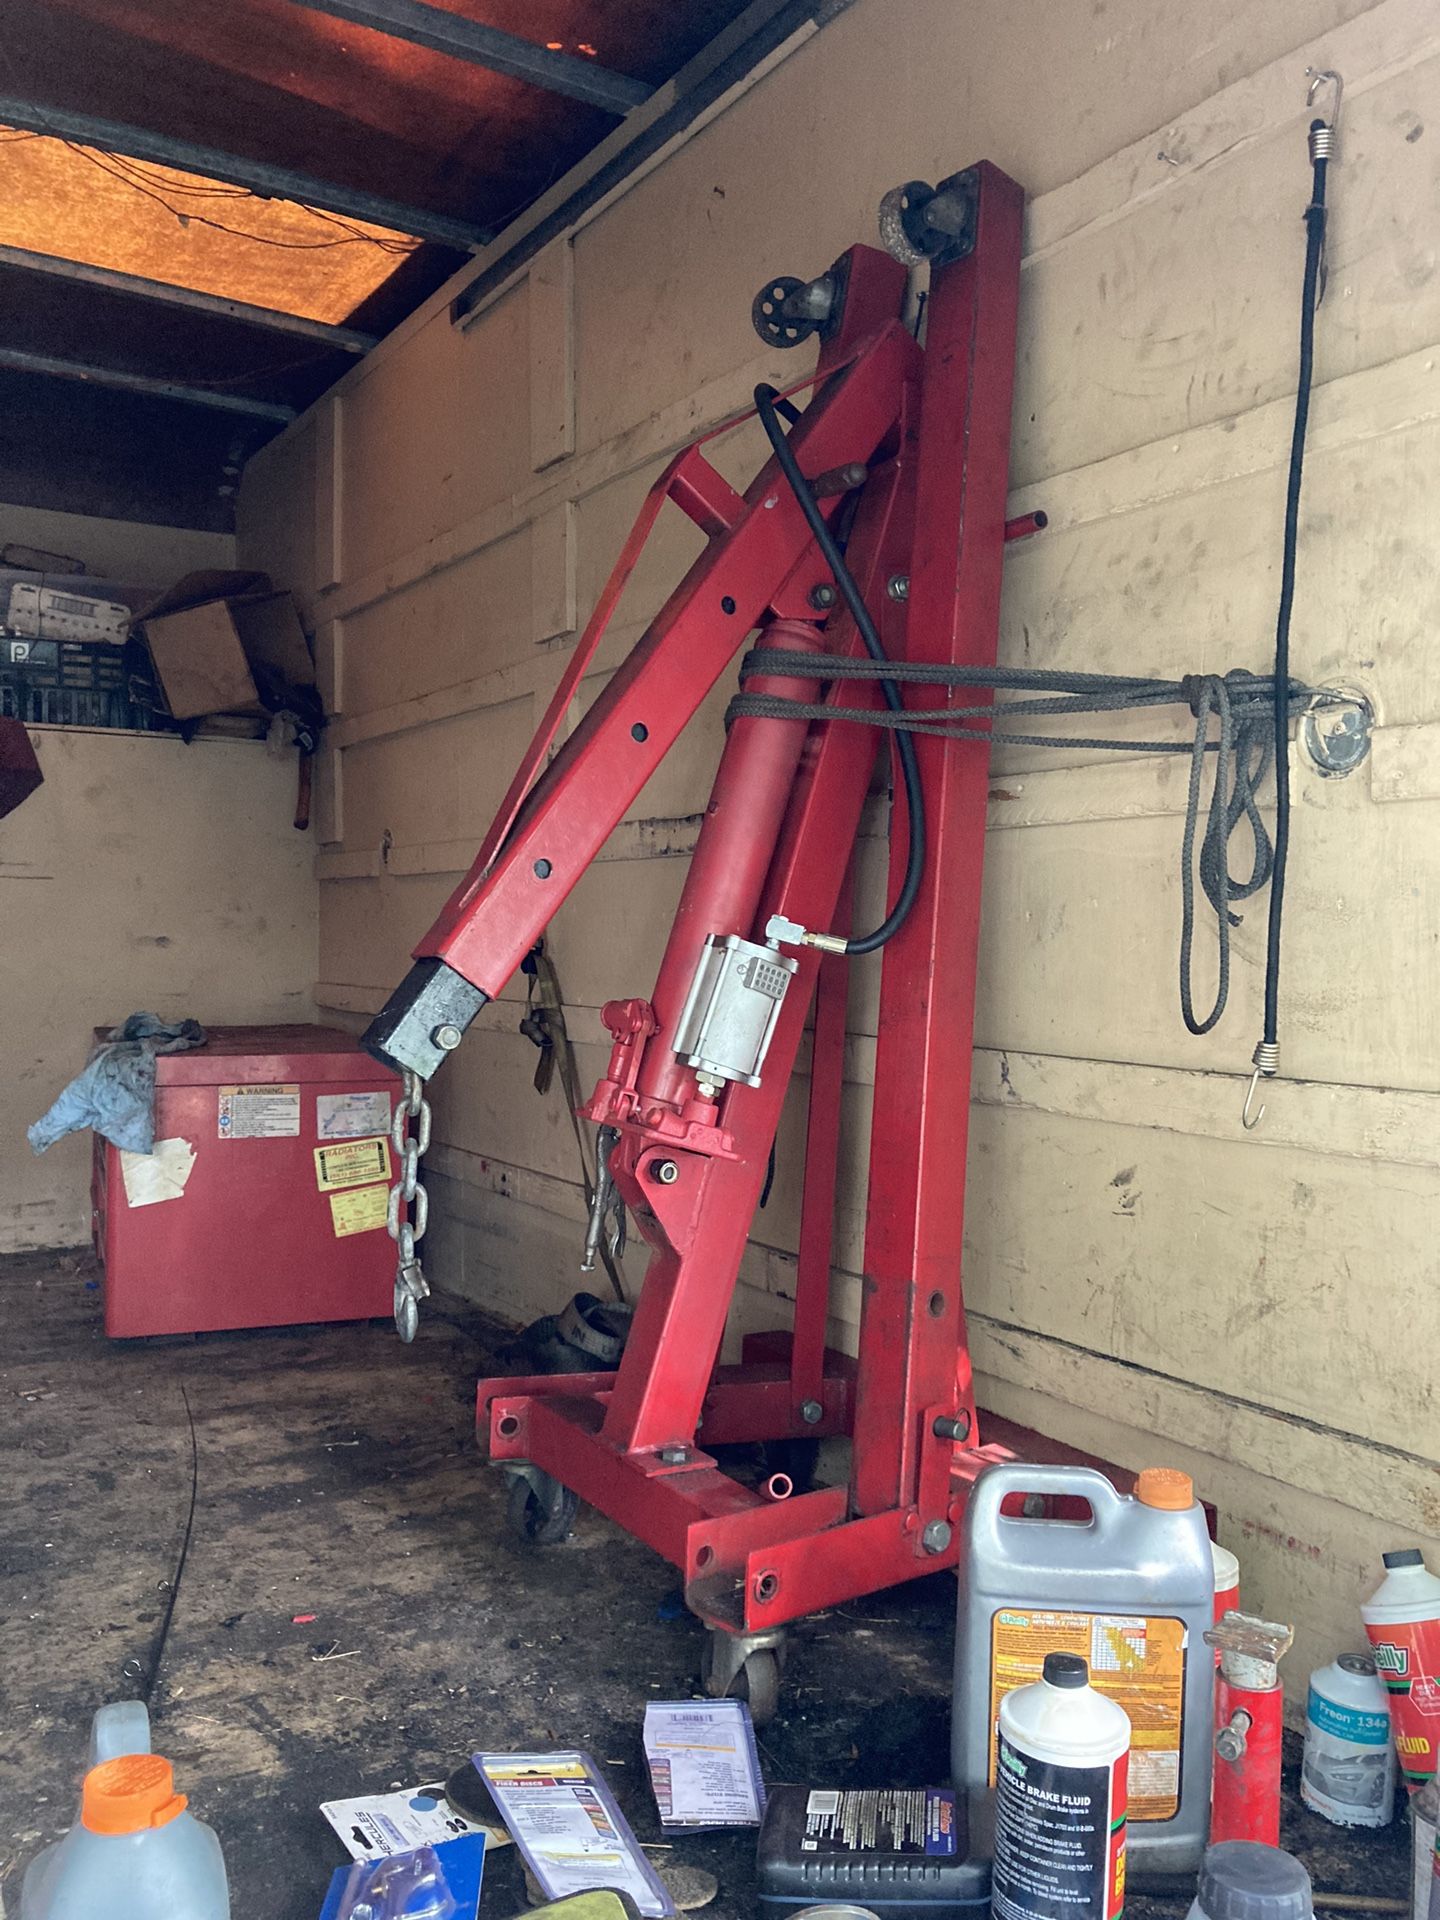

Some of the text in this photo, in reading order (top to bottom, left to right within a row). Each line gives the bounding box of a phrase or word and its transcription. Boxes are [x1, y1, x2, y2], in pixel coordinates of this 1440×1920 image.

[246, 1088, 284, 1096] WARNING
[324, 1143, 378, 1158] RADIATORS
[1375, 1645, 1405, 1671] eilly
[1319, 1701, 1388, 1729] Freon 134a
[1027, 1785, 1060, 1803] BRAKE
[1062, 1795, 1092, 1806] FLUID
[354, 1811, 393, 1857] HERCULES
